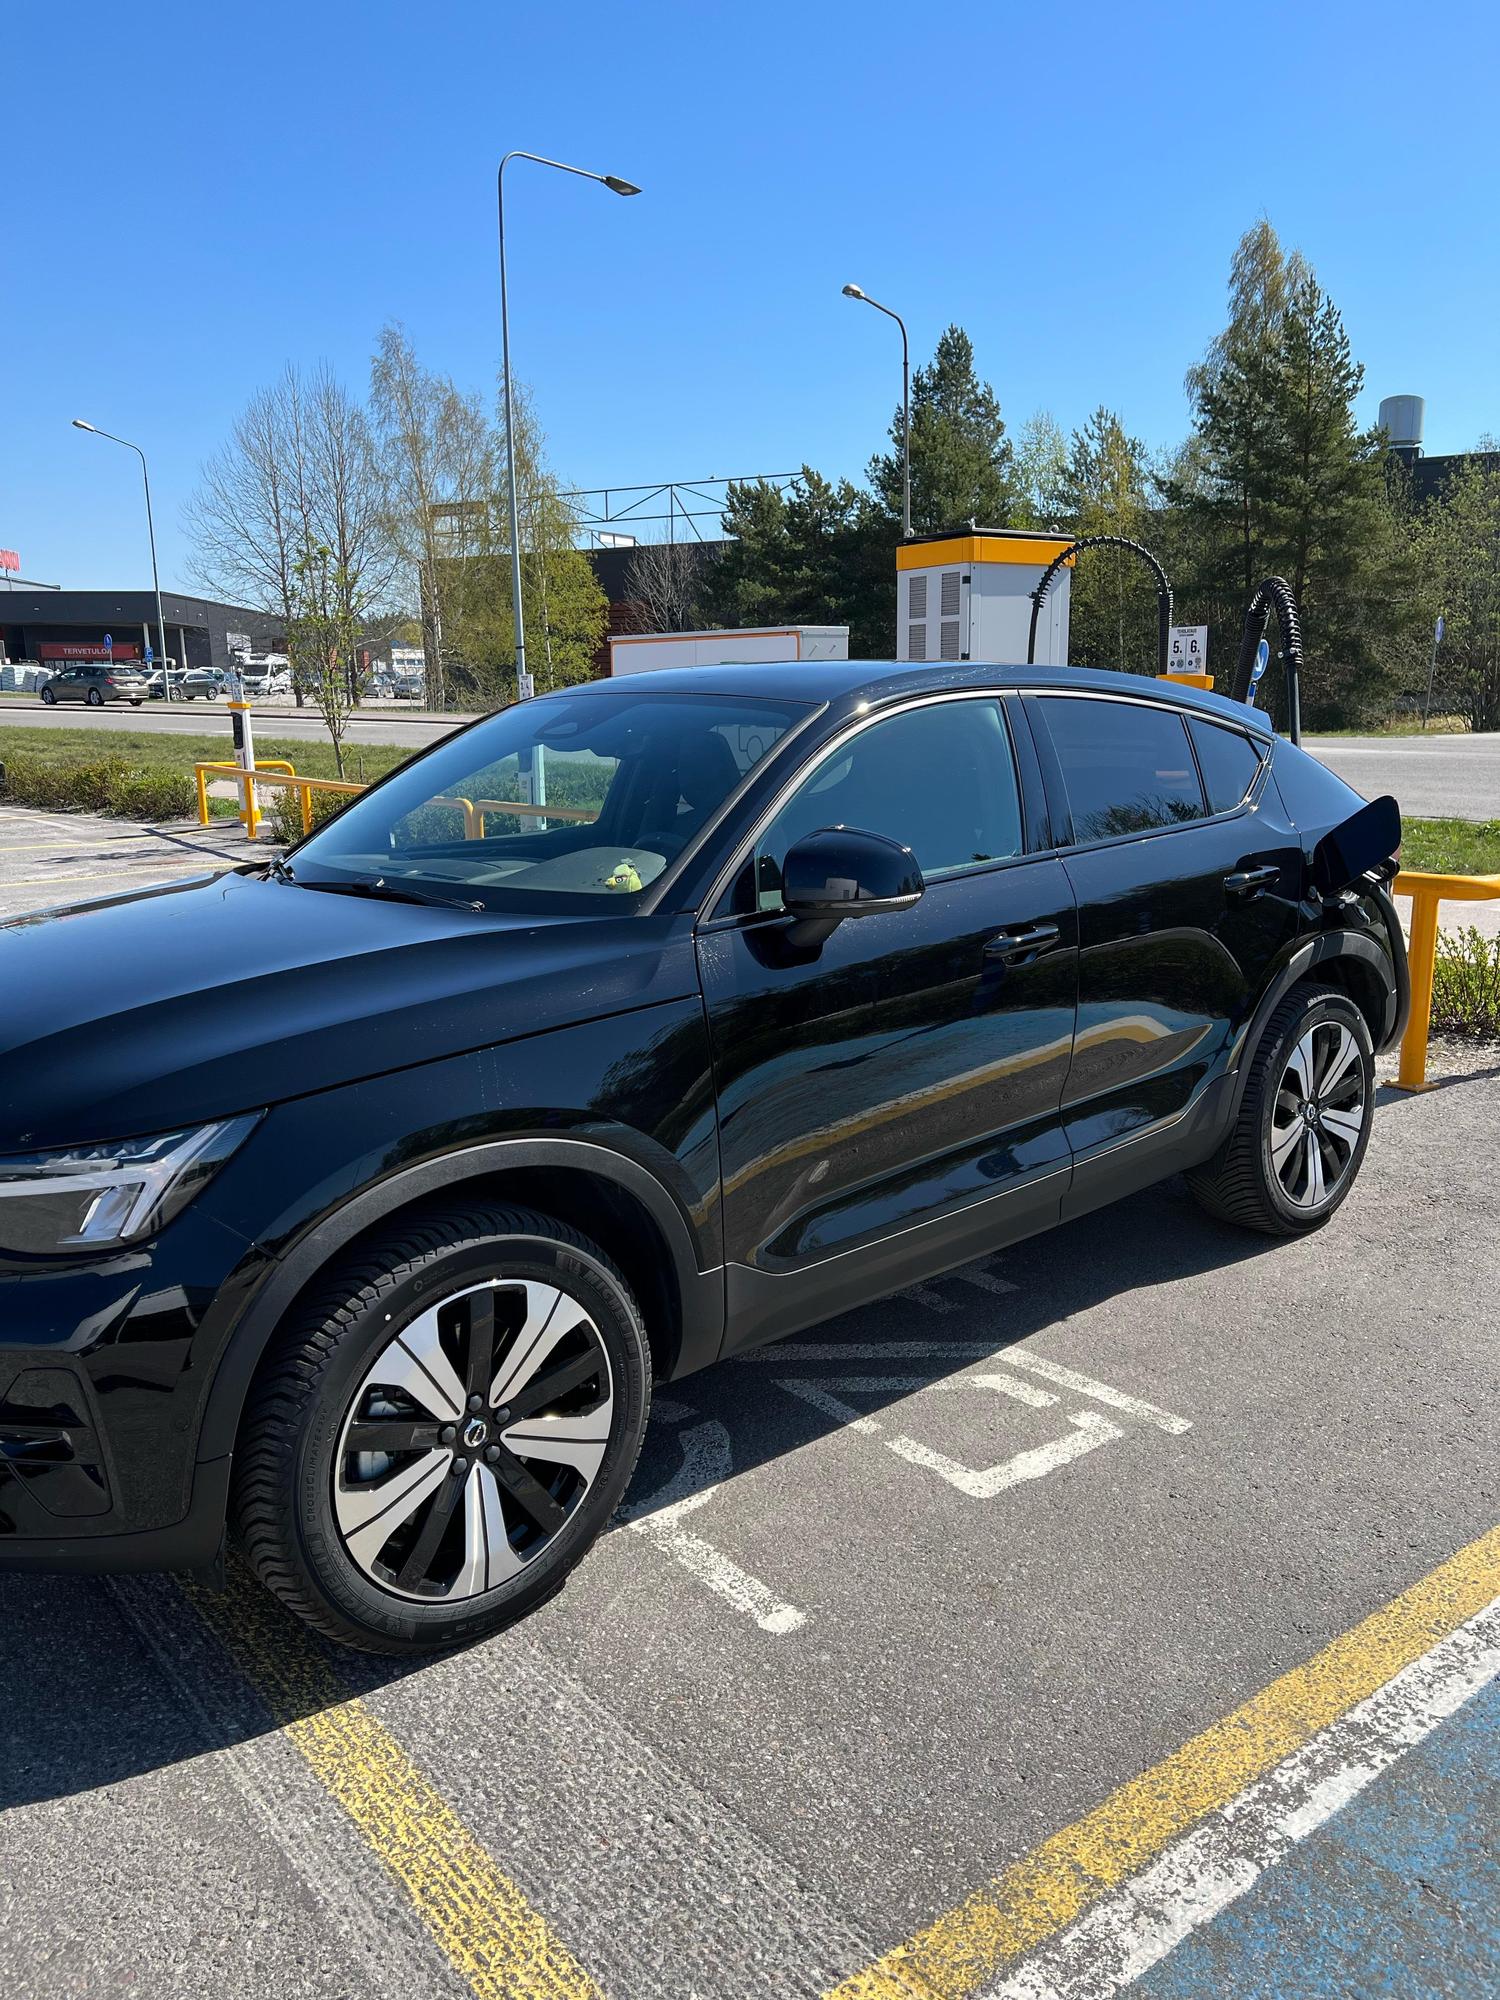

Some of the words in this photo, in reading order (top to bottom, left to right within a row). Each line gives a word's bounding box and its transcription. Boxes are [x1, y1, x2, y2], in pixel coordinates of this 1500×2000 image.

[1173, 640, 1182, 654] 5.
[1190, 639, 1200, 653] 6.
[308, 1540, 383, 1627] MICHELIN
